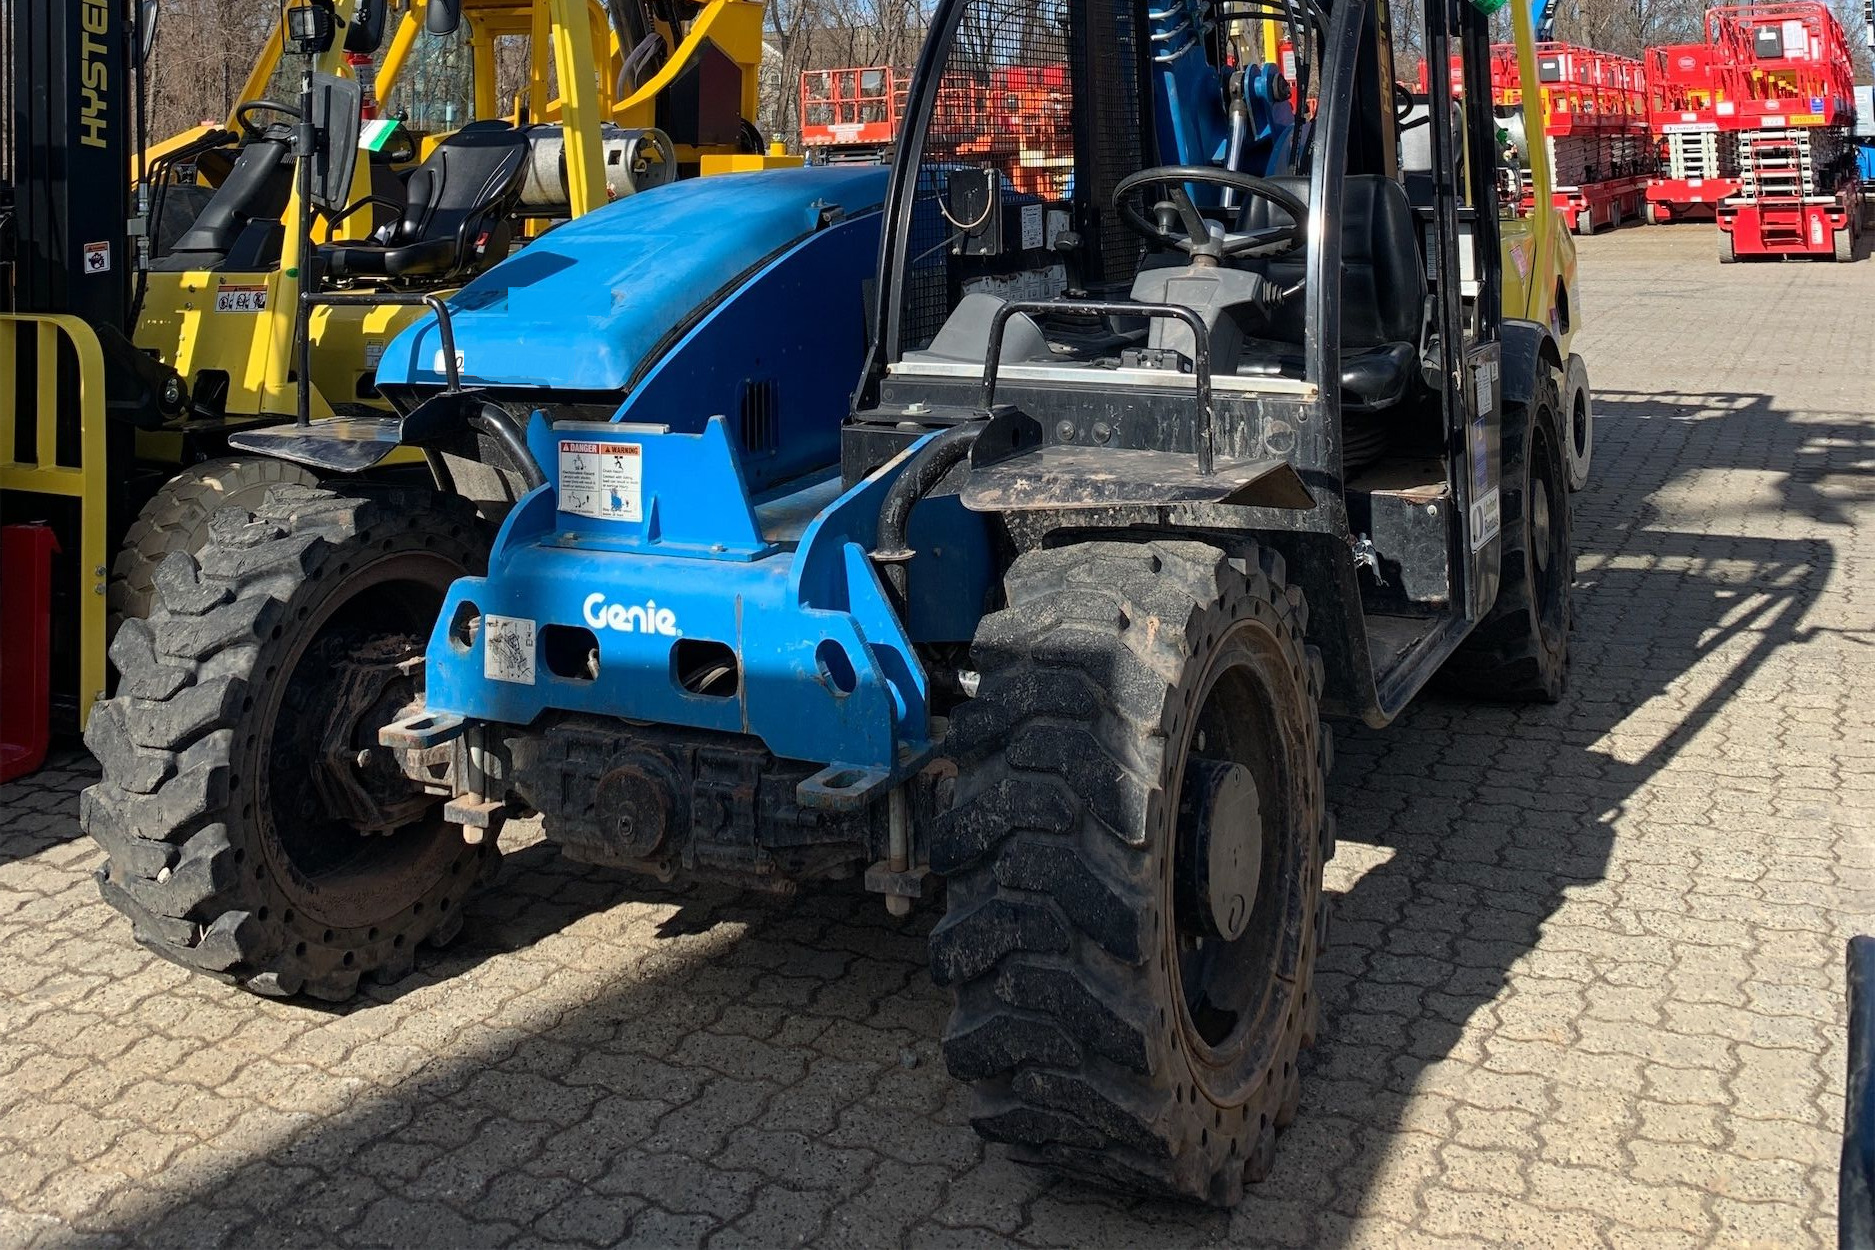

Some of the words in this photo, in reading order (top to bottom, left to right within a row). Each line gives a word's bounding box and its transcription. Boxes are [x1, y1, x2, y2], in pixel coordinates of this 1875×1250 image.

[570, 442, 598, 454] DANGER
[611, 445, 639, 455] WARNING
[582, 591, 677, 637] Genie
